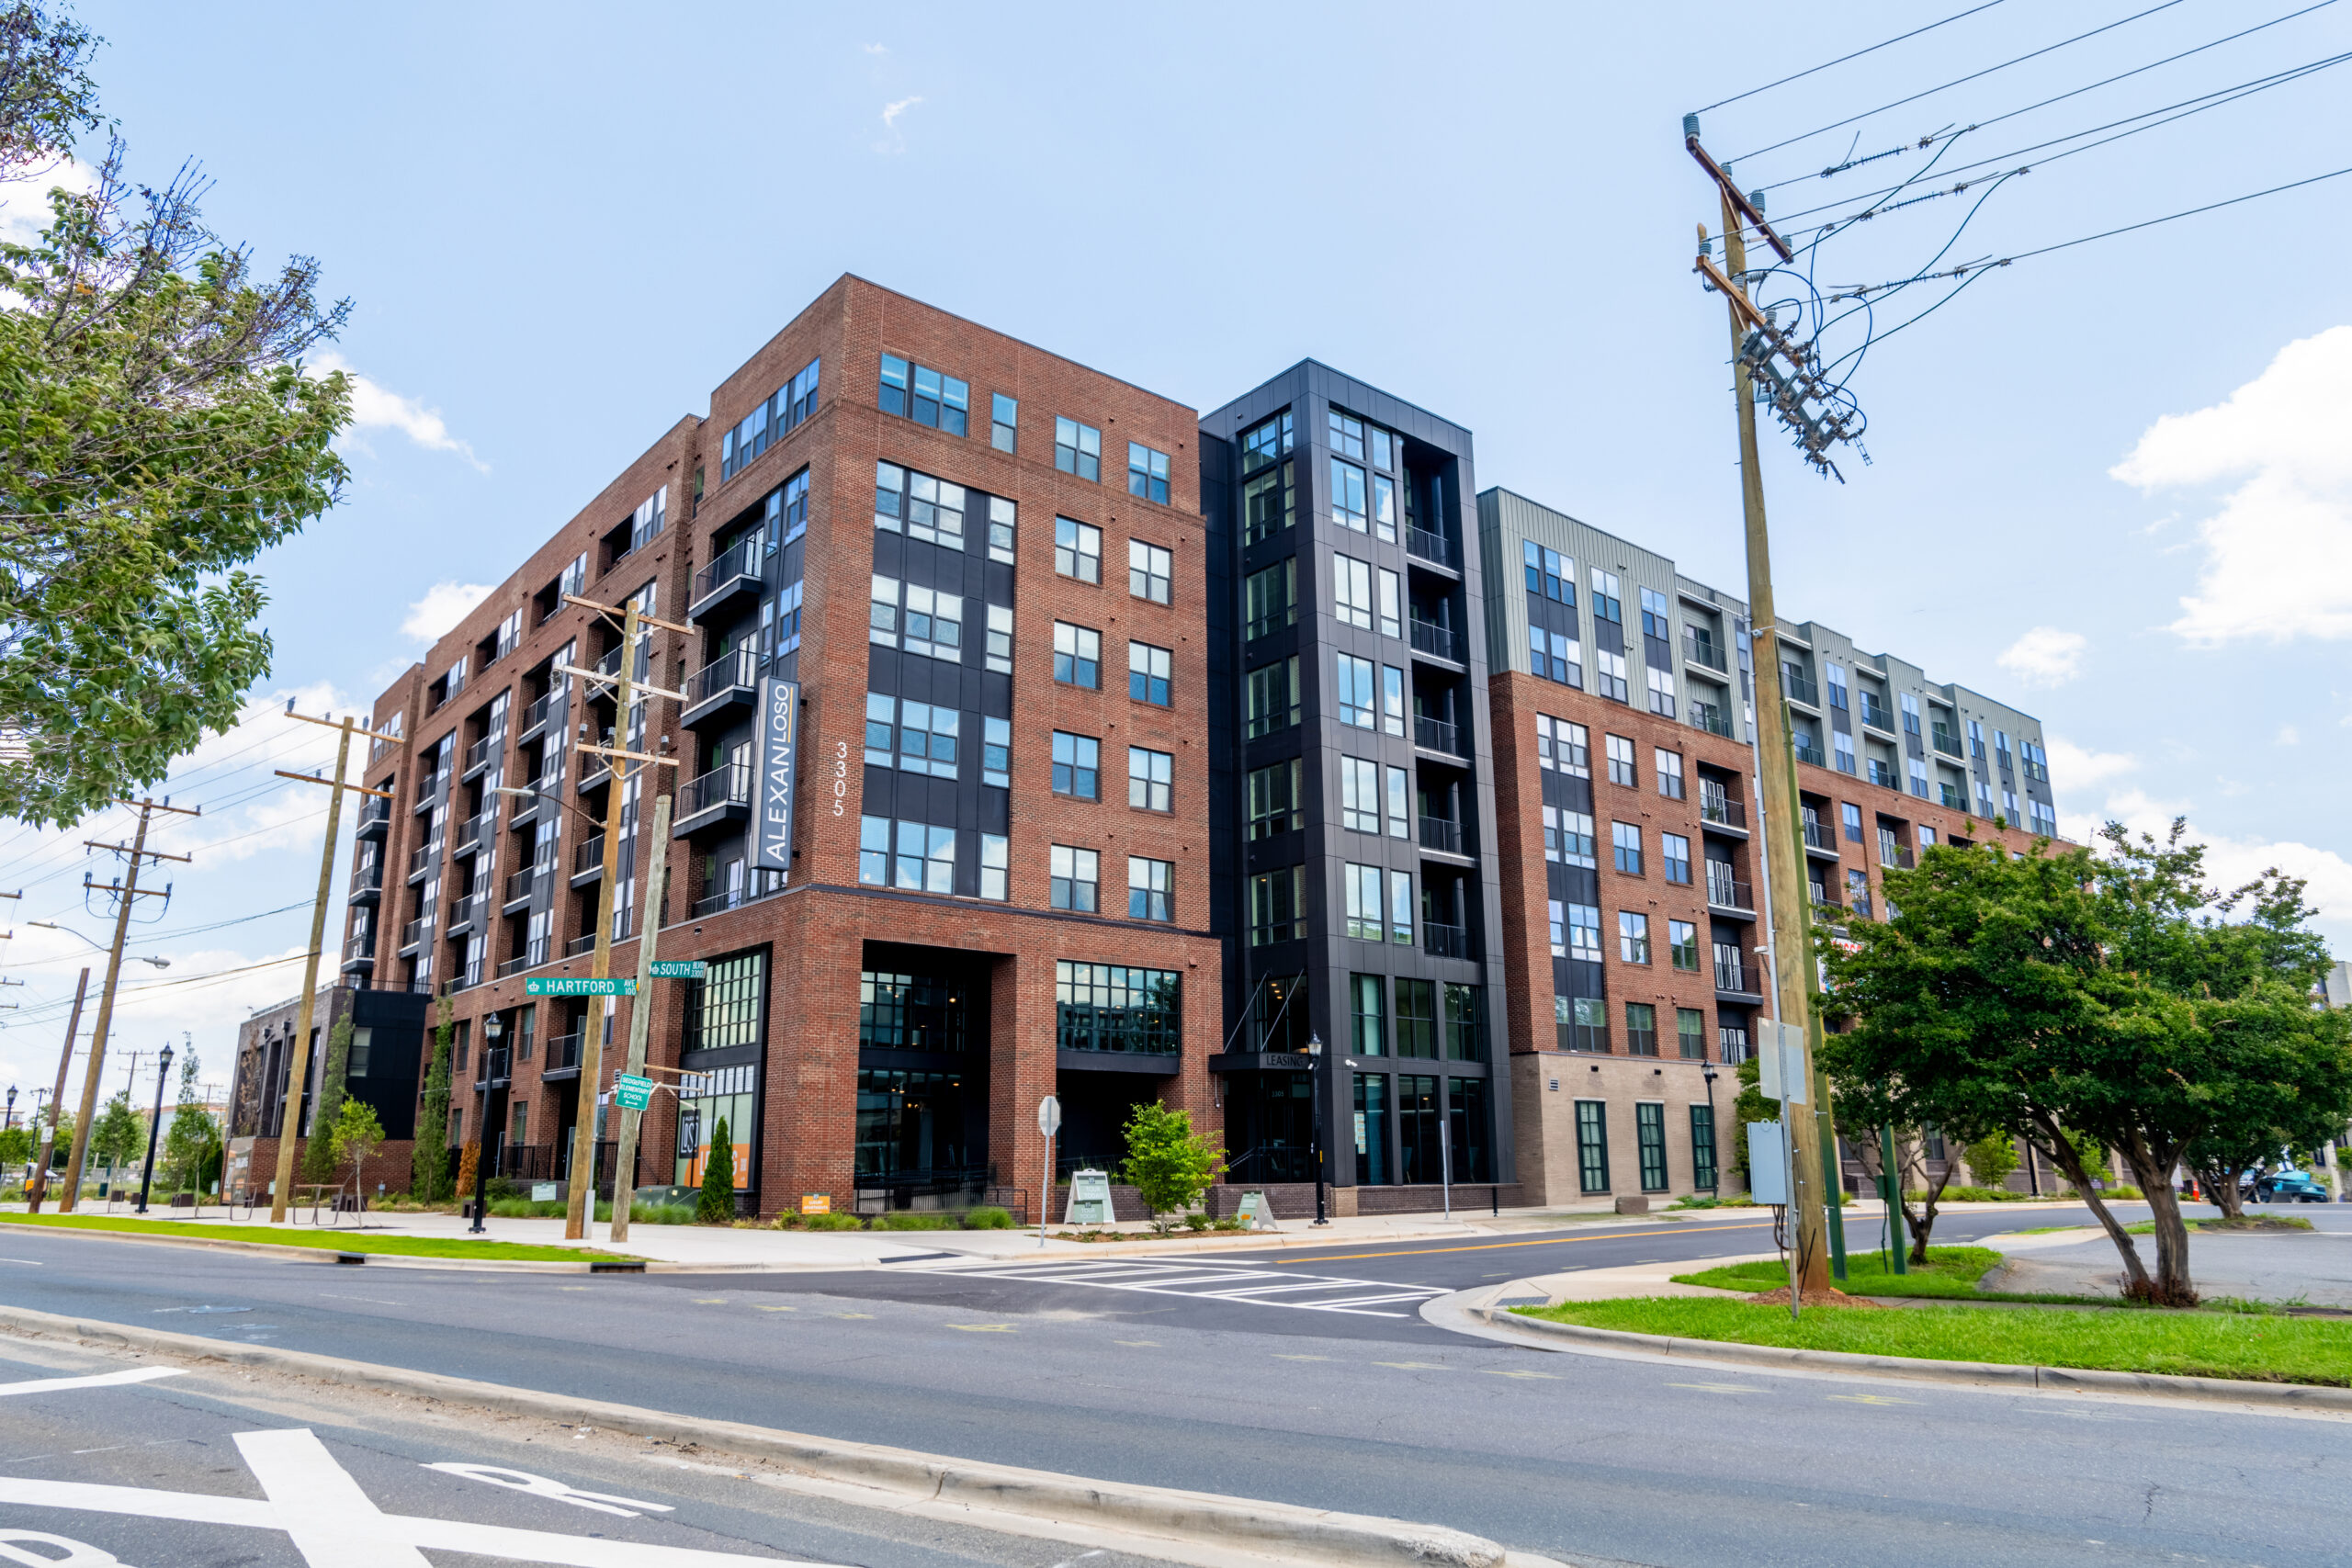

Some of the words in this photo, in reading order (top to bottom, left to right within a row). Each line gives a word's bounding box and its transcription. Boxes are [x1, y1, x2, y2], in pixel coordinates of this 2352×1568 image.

[773, 684, 789, 743] LOSO
[833, 741, 848, 817] 3305
[766, 745, 790, 863] ALEXAN
[660, 963, 691, 976] SOUTH
[692, 961, 705, 969] BLVD
[691, 969, 705, 977] 3300
[547, 980, 616, 993] HARTFORD
[1267, 1055, 1304, 1066] LEASING
[619, 1084, 649, 1094] ELEMENTARY
[623, 1092, 643, 1101] SCHOOL
